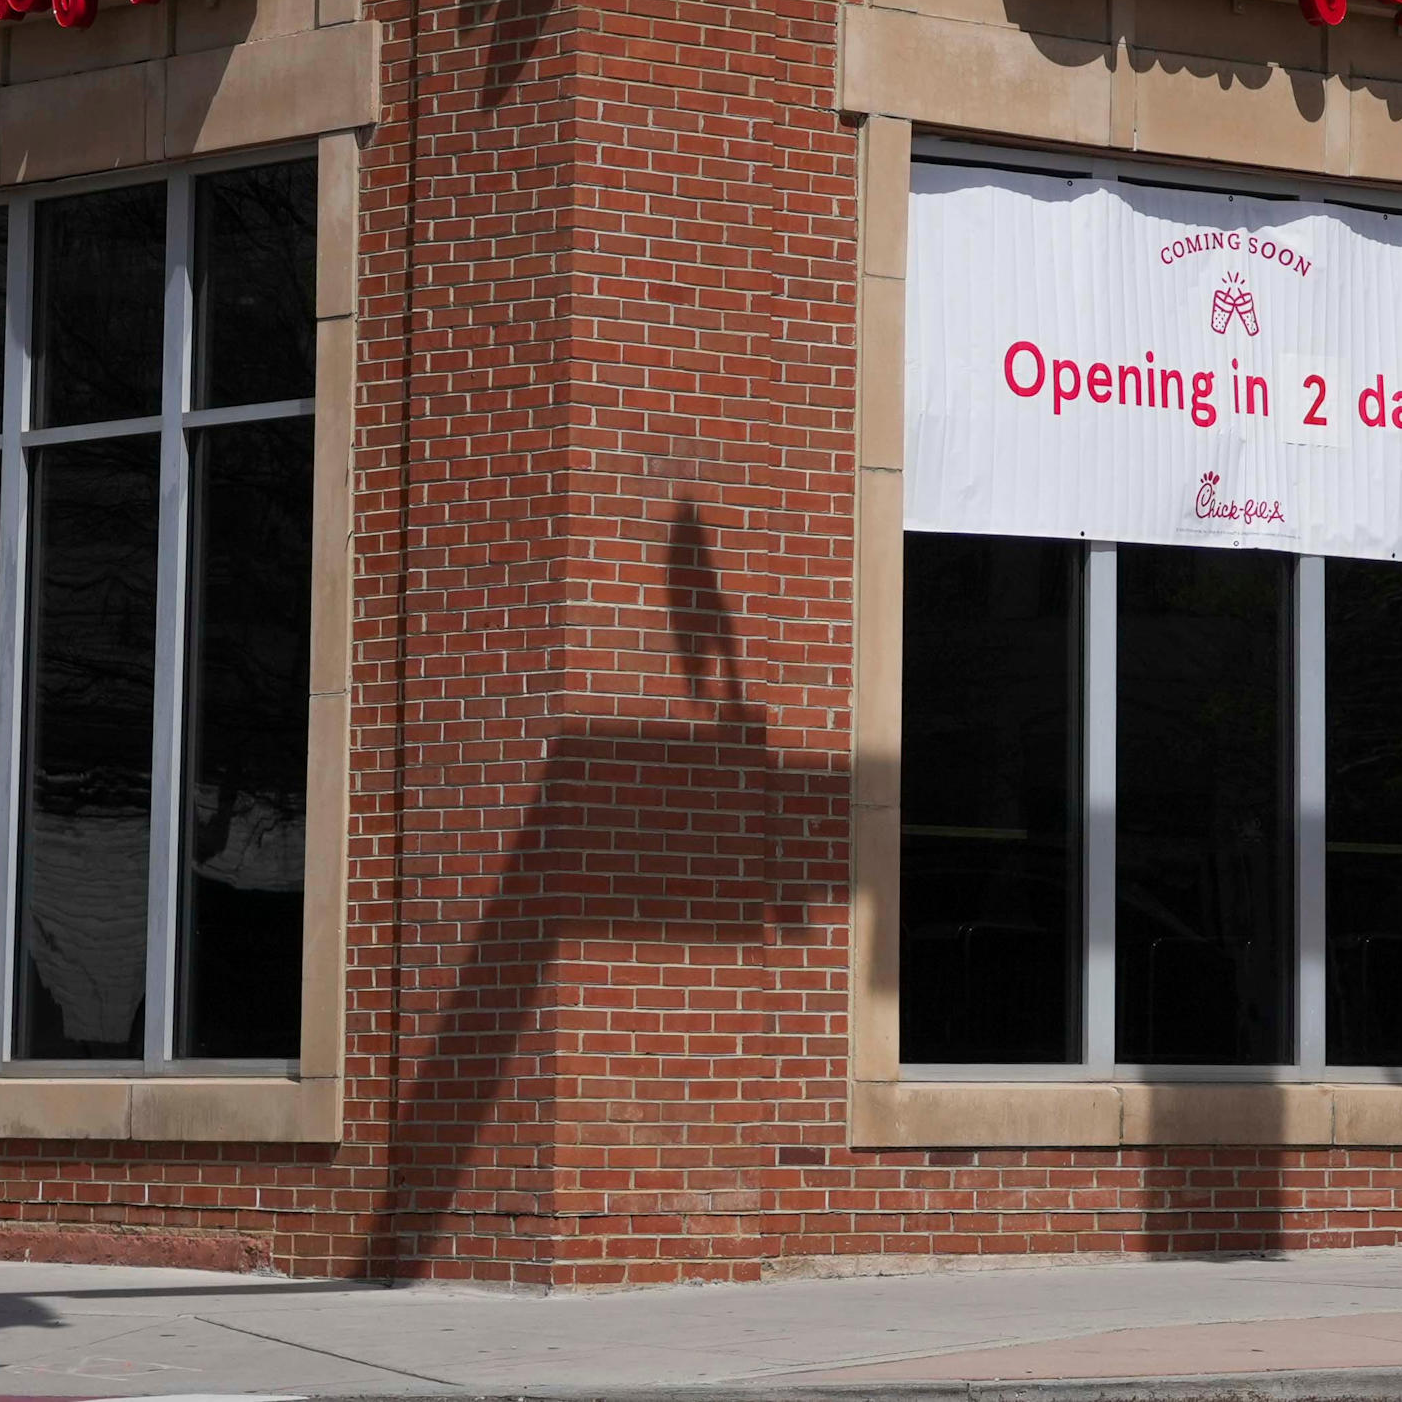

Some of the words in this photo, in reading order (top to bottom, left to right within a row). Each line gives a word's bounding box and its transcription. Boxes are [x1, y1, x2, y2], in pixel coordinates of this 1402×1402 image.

[1160, 232, 1242, 265] COMING
[1248, 237, 1312, 277] SOON
[1004, 340, 1216, 428] Opening
[1231, 358, 1269, 417] in
[1302, 374, 1328, 426] 2
